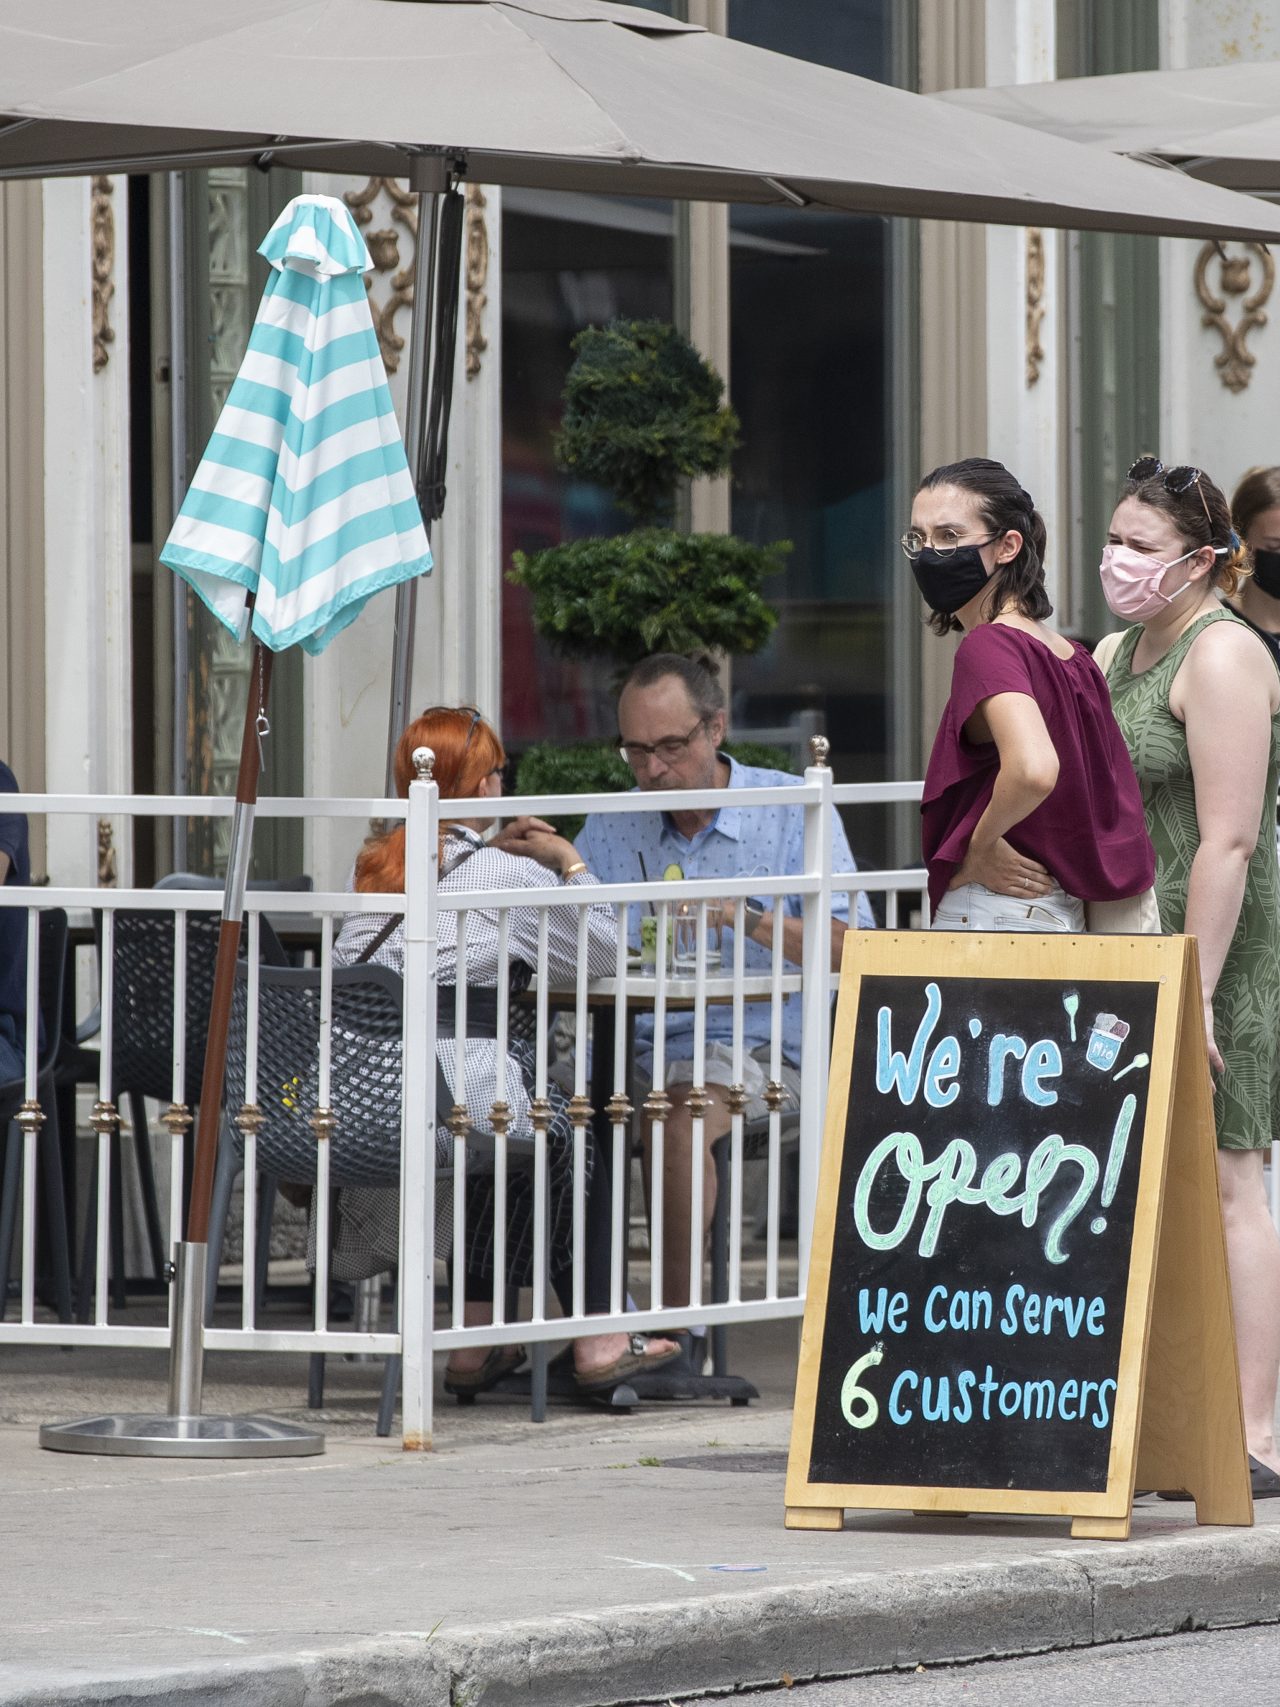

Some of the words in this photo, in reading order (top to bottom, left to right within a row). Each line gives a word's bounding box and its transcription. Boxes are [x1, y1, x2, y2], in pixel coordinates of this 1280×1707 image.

[876, 982, 1063, 1108] We're
[854, 1093, 1137, 1265] Open!
[841, 1350, 883, 1430] 6
